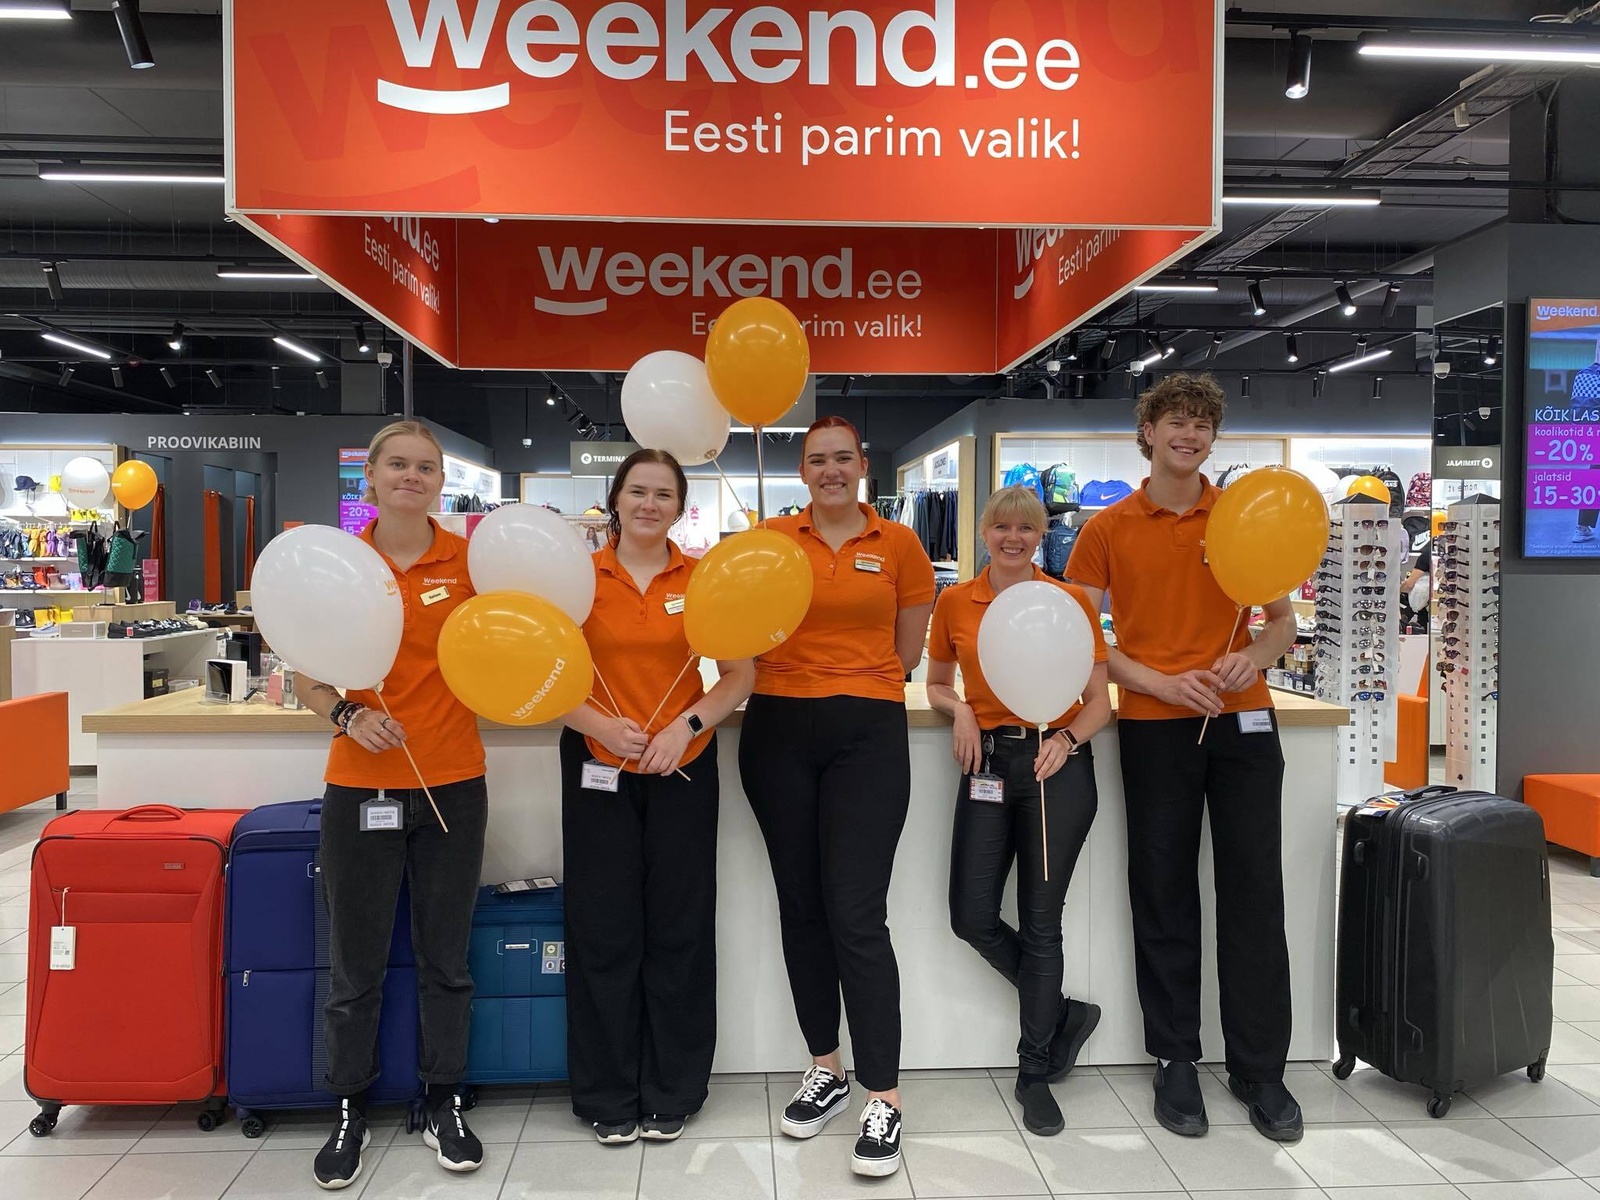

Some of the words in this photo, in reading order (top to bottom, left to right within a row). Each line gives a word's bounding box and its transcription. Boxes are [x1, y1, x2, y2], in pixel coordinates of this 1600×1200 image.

[384, 0, 1080, 90] Weekend.ee
[665, 109, 782, 154] Eesti
[802, 114, 941, 166] parim
[958, 117, 1080, 159] valik!
[364, 222, 390, 272] Eesti
[392, 257, 419, 297] parim
[419, 282, 440, 315] valik!
[535, 246, 922, 299] Weekend.ee
[1058, 238, 1083, 286] Eesti
[854, 313, 922, 338] valik!
[1534, 405, 1569, 422] KÕIK
[147, 435, 261, 449] PROOVIKABIIN
[1534, 426, 1584, 437] koolikotid
[1586, 426, 1594, 437] &
[593, 455, 628, 463] TERMINA
[1534, 439, 1594, 462] -20%
[1532, 470, 1572, 484] jalatsid
[1533, 485, 1600, 506] 15-30
[343, 506, 370, 517] -20%
[423, 577, 457, 585] Weekend
[510, 657, 566, 718] Weekend
